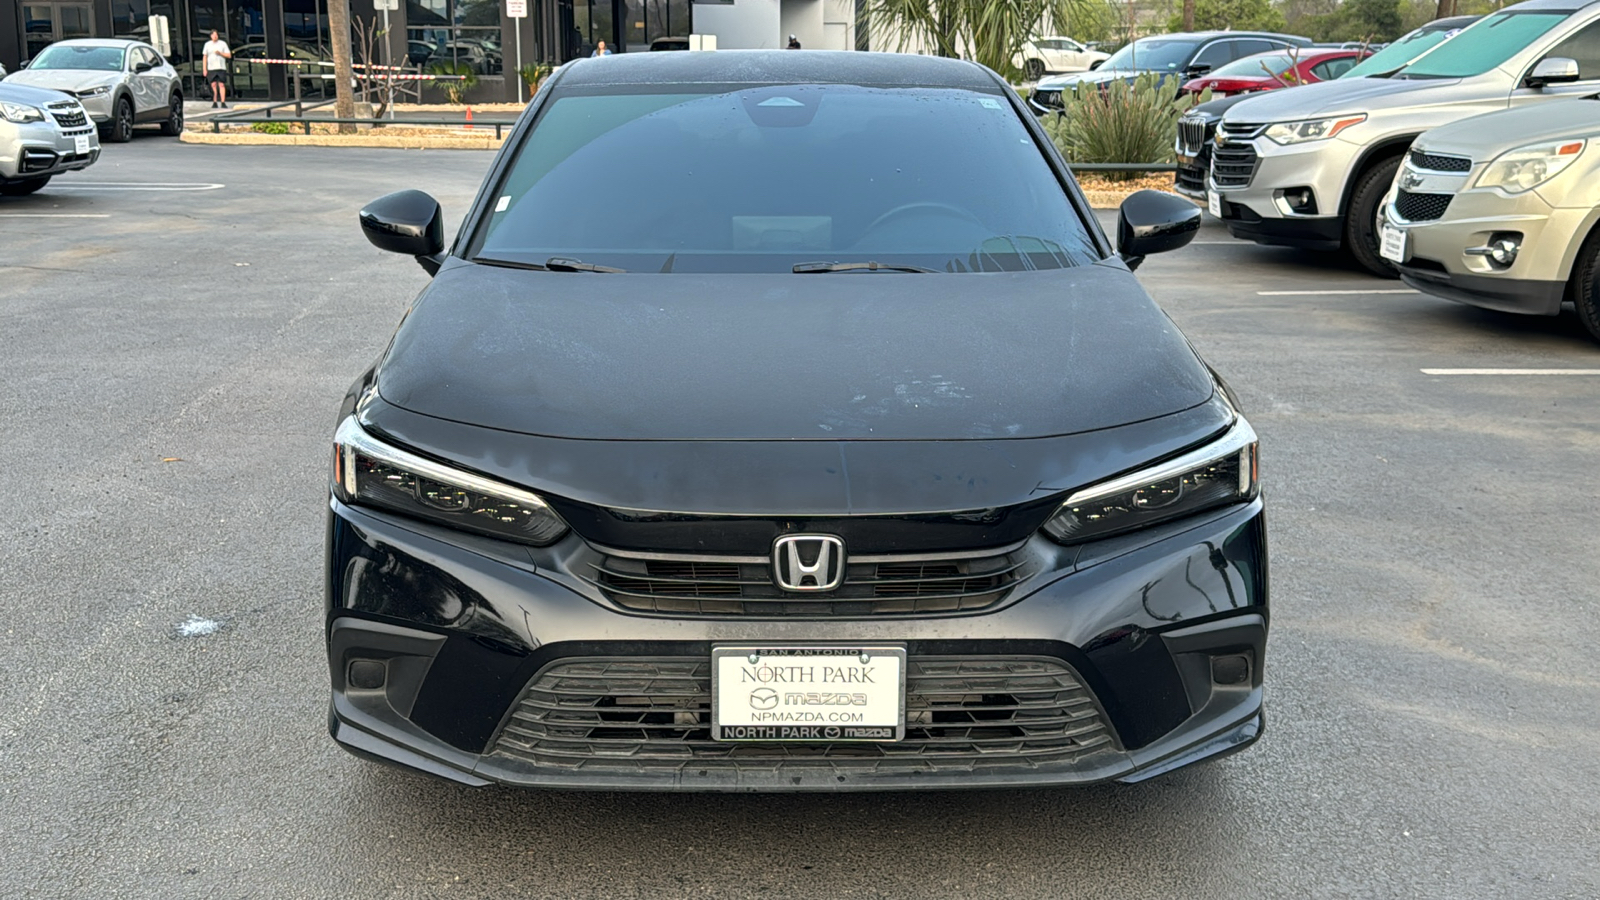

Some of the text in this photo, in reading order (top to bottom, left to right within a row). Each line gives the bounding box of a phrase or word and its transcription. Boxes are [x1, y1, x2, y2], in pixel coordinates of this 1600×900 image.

[740, 666, 876, 683] NORTH PARK
[785, 692, 867, 706] mazda
[751, 712, 863, 722] NPMAZDA.COM
[724, 726, 892, 739] NORTH PARK mazda
